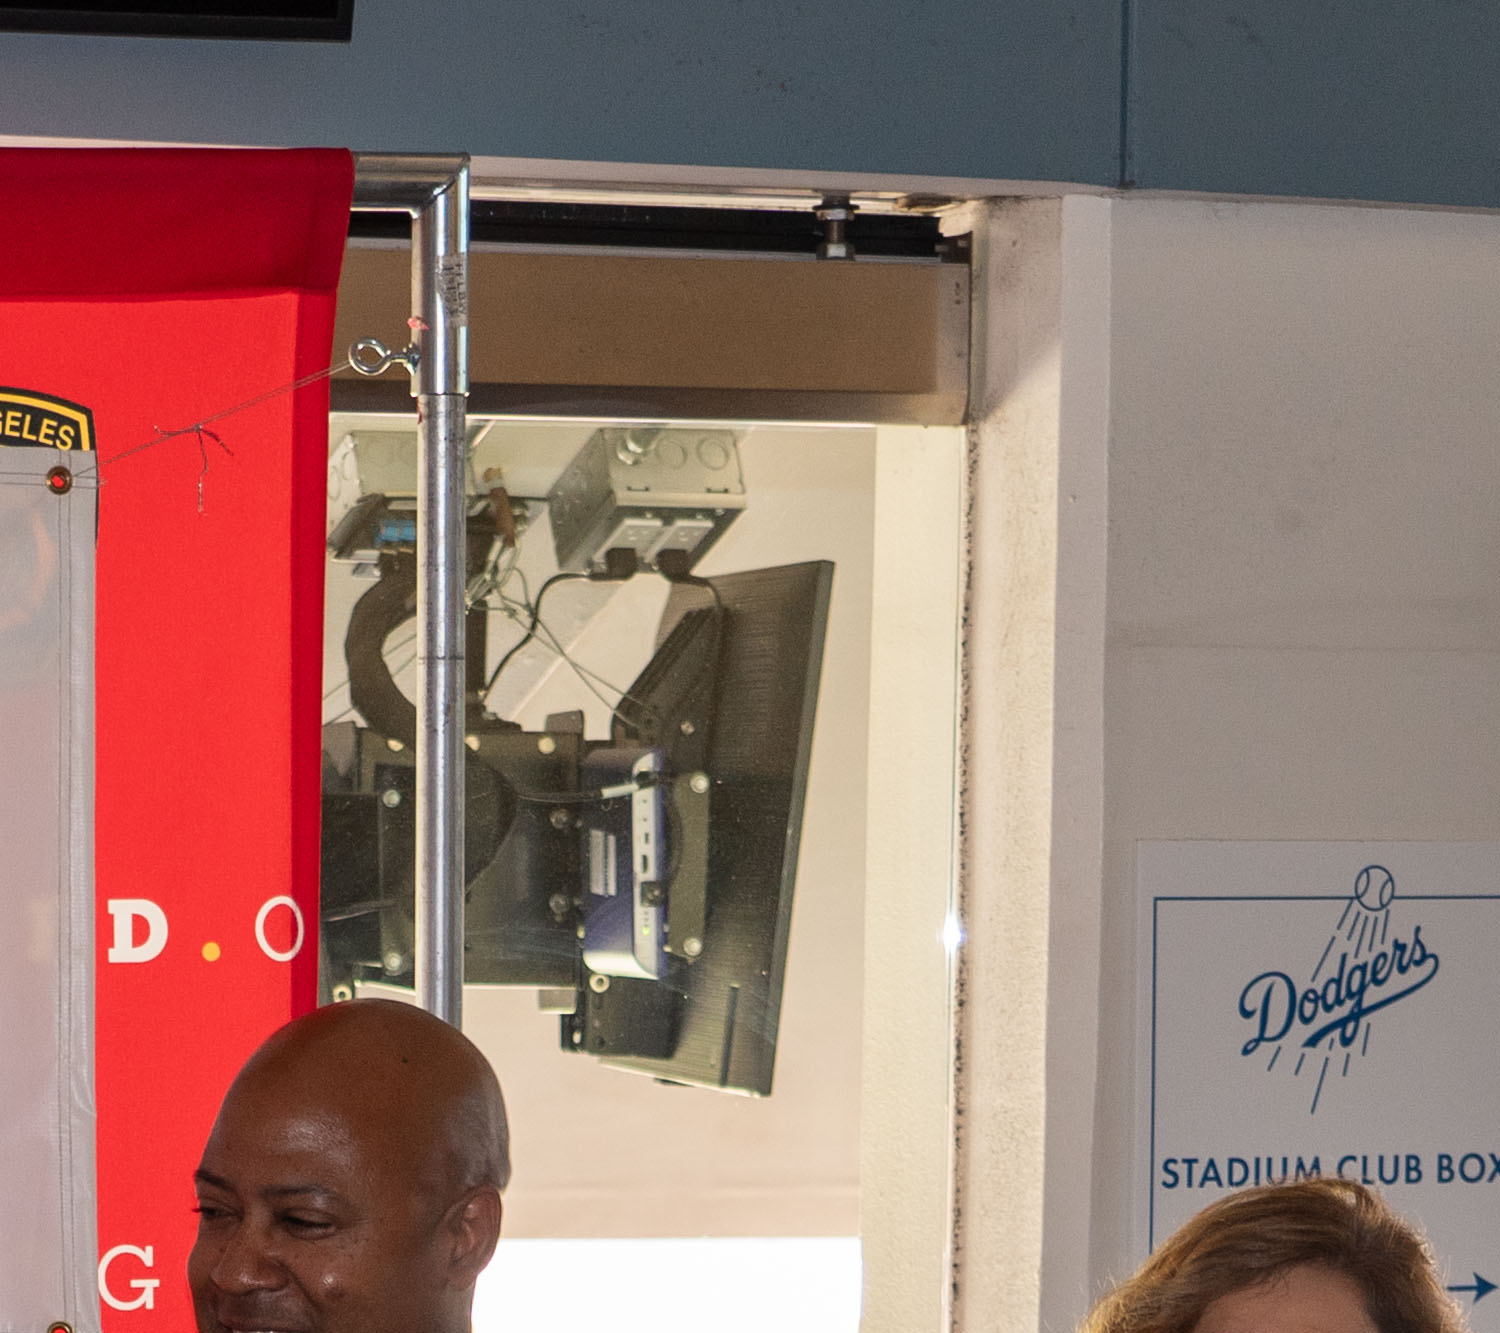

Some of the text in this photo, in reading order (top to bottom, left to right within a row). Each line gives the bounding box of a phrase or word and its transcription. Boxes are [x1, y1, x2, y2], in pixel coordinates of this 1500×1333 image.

[1239, 925, 1439, 1056] Dodgers
[1161, 1156, 1322, 1190] STADIUM
[1336, 1154, 1423, 1186] CLUB
